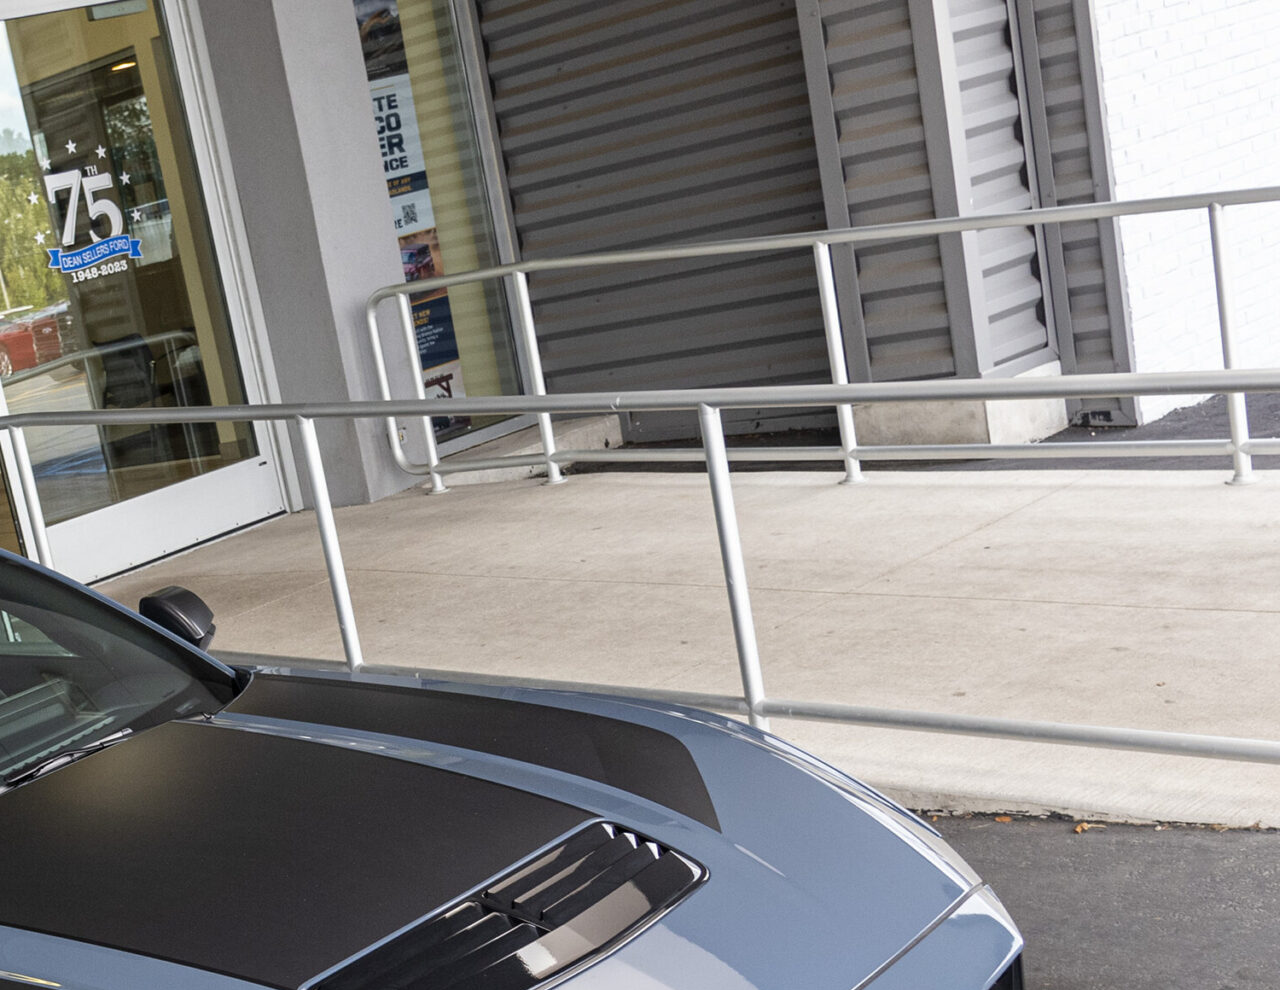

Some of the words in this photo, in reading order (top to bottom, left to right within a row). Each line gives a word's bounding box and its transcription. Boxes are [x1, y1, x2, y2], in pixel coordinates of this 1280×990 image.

[84, 165, 98, 177] TH
[44, 169, 124, 246] 75
[62, 255, 83, 268] DEAN
[82, 244, 110, 263] SELLERS
[109, 239, 129, 251] FORD
[71, 260, 128, 283] 1948-2023
